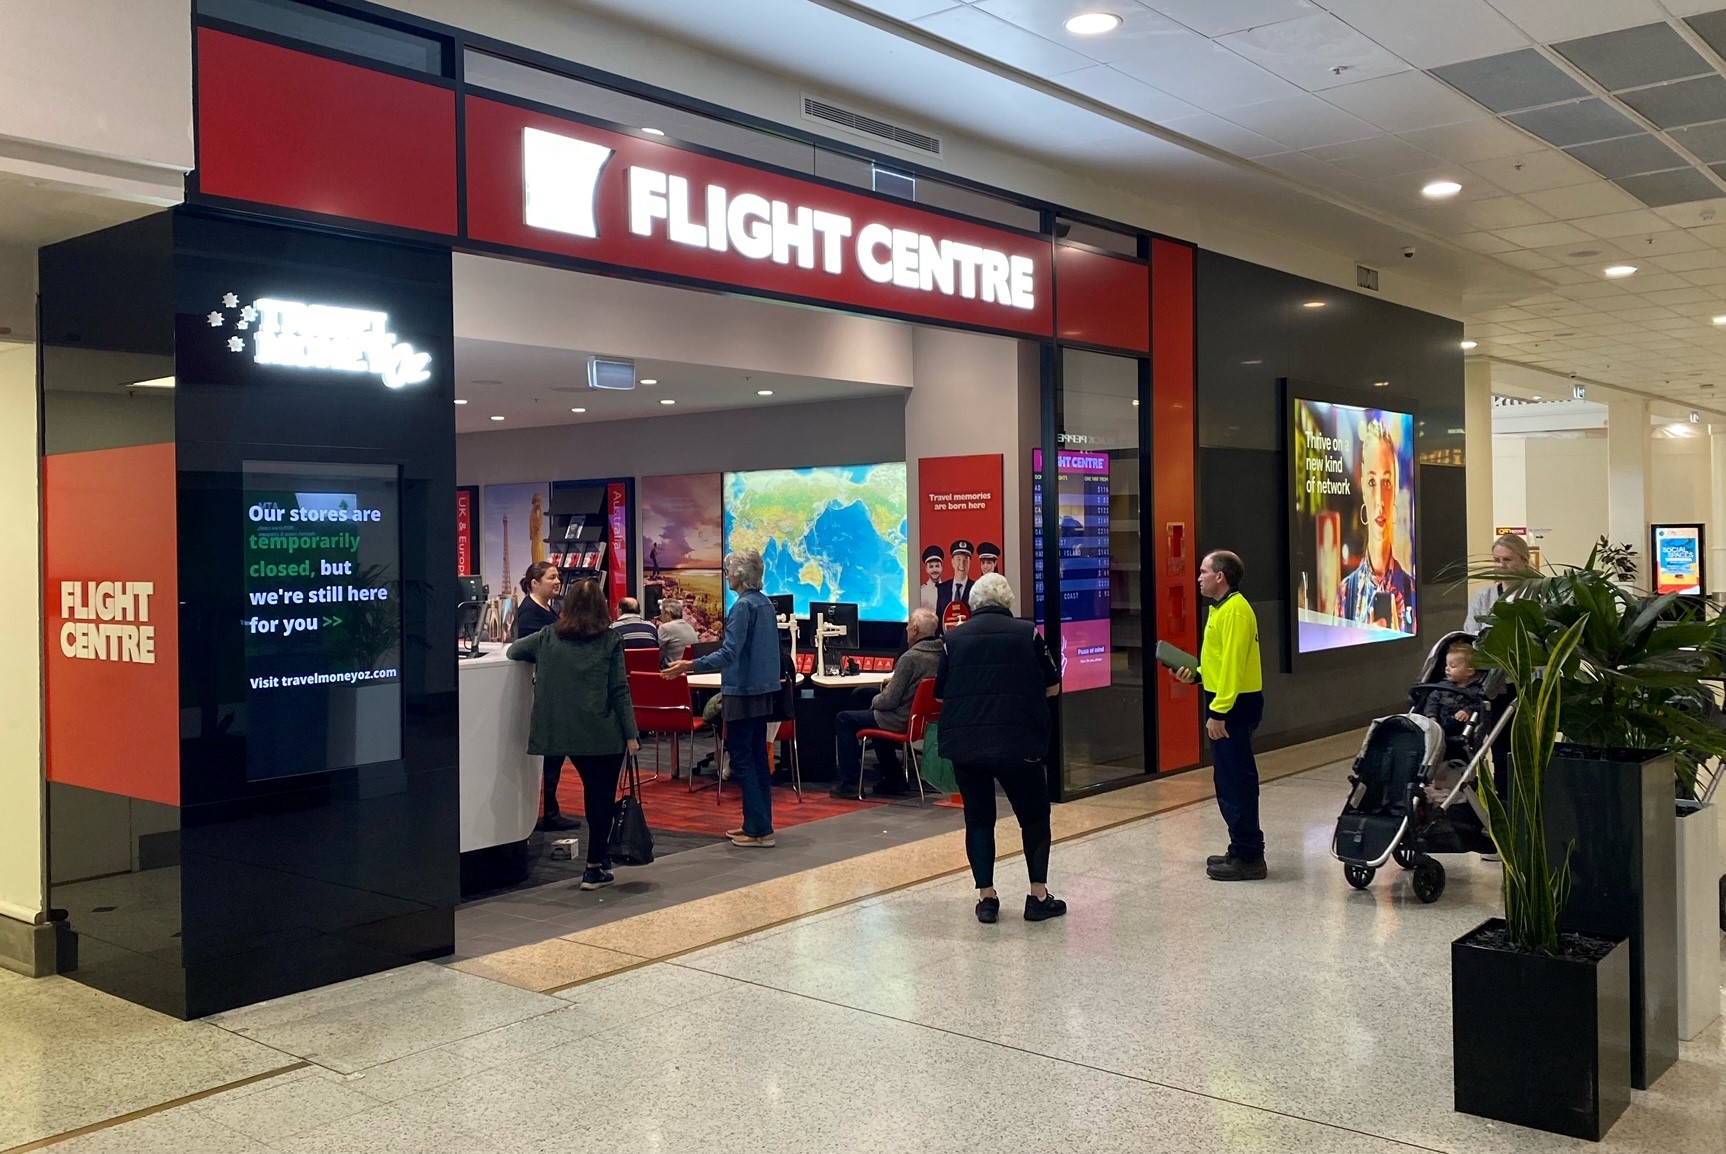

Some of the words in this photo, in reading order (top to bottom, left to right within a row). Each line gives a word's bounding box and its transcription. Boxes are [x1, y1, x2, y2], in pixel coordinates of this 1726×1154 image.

[627, 165, 852, 275] FLIGHT
[856, 222, 1035, 310] CENTRE
[1305, 431, 1331, 450] Thrive
[1332, 438, 1343, 451] on
[1344, 439, 1350, 452] a
[1071, 457, 1104, 469] CENTRE
[1306, 457, 1323, 471] new
[1325, 454, 1343, 473] kind
[1306, 476, 1316, 493] of
[1317, 478, 1351, 495] network
[458, 497, 466, 517] UK
[929, 493, 952, 502] Travel
[953, 492, 991, 501] memories
[968, 502, 986, 510] here
[248, 505, 285, 522] Our
[289, 507, 348, 522] stores
[352, 508, 381, 522] are
[613, 491, 624, 550] Australia
[458, 522, 467, 531] &
[249, 532, 360, 553] temporarily
[249, 559, 315, 578] closed,
[320, 559, 352, 575] but
[61, 580, 155, 622] FLIGHT
[249, 588, 304, 605] we're
[308, 586, 343, 603] still
[347, 585, 388, 602] here
[1063, 592, 1079, 600] COAST
[250, 616, 279, 633] for
[282, 617, 318, 637] you
[60, 622, 156, 664] CENTRE
[250, 676, 279, 690] Visit
[281, 668, 397, 687] travelmoneyoz.com
